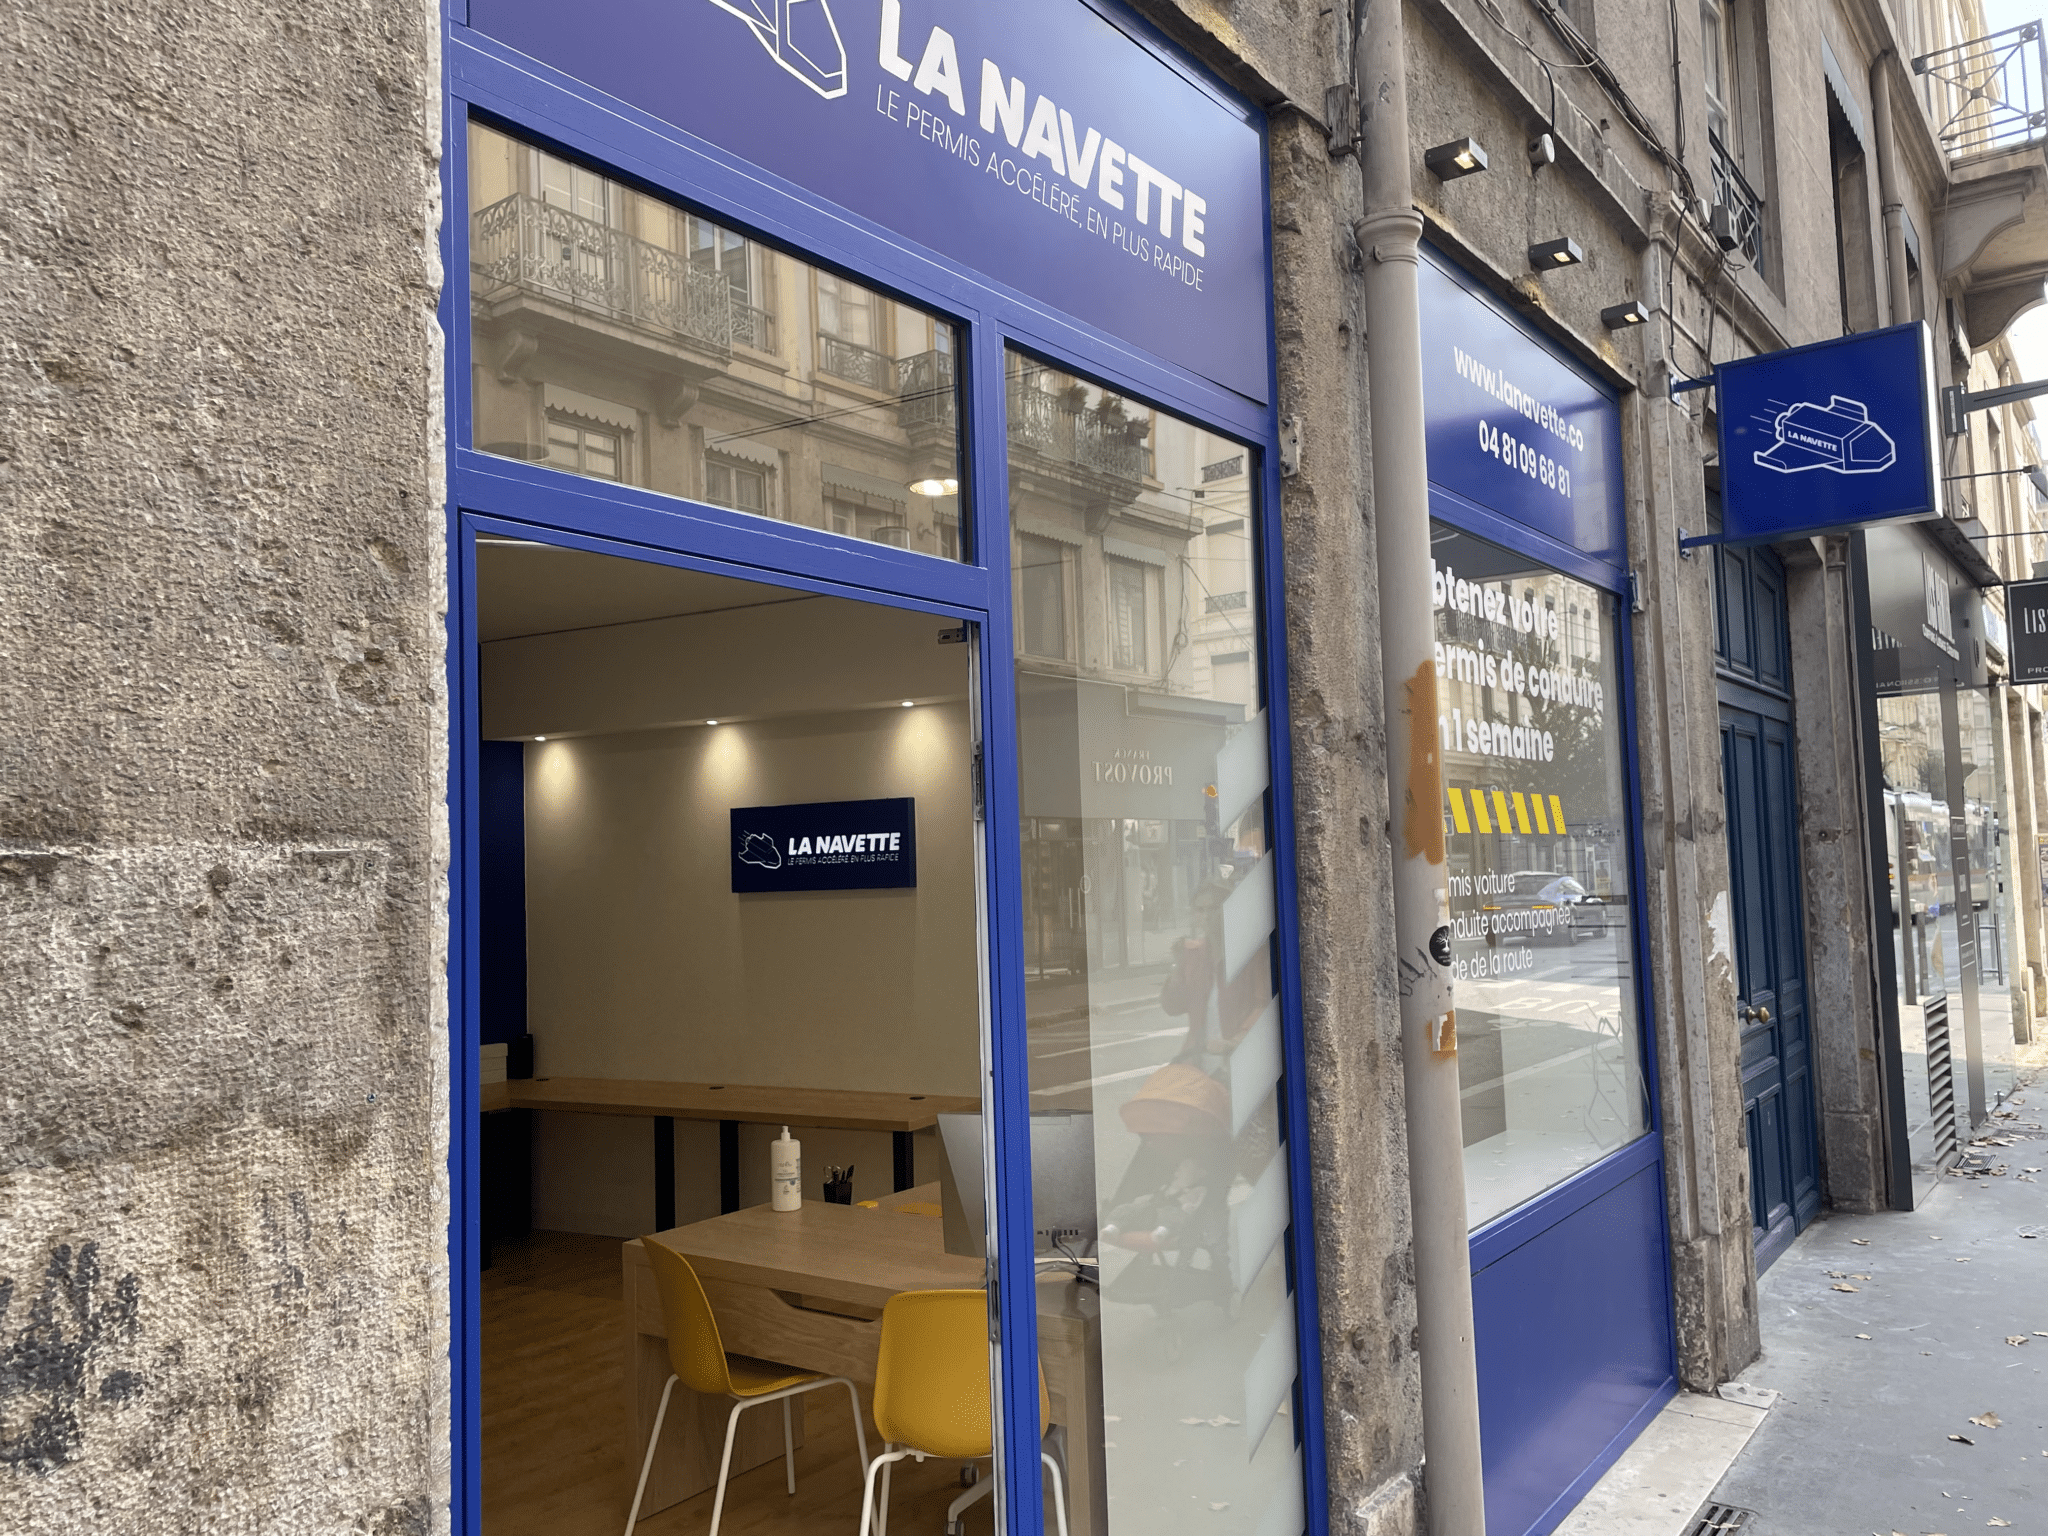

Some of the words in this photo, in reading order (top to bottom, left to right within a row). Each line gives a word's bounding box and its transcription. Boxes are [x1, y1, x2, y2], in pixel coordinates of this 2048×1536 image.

[879, 0, 966, 116] LA
[979, 58, 1208, 258] NAVETTE
[876, 83, 901, 122] LE
[906, 101, 981, 167] PERMIS
[985, 152, 1083, 229] ACCÉLÉRÉ,
[1086, 206, 1108, 240] EN
[1112, 221, 1150, 262] PLUS
[1153, 244, 1204, 292] RAPIDE
[1453, 345, 1584, 452] www.lanavette.co
[1478, 419, 1500, 459] 04
[1502, 432, 1518, 469] 81
[1519, 443, 1537, 479] 09
[1539, 453, 1556, 490] 68
[1557, 464, 1571, 499] 81
[1787, 430, 1799, 440] LA
[1799, 434, 1838, 452] NAVETTE
[1431, 558, 1507, 626] btenez
[1508, 595, 1558, 641] votre
[2023, 607, 2048, 634] LIS
[1434, 638, 1498, 689] ermis
[1500, 650, 1526, 694] de
[1528, 665, 1604, 711] conduire
[1438, 714, 1450, 751] n
[1452, 708, 1463, 752] 1
[1466, 714, 1554, 763] semaine
[788, 836, 812, 856] LA
[815, 832, 901, 854] NAVETTE
[1448, 868, 1472, 898] mis
[1473, 867, 1516, 896] voiture
[1449, 908, 1489, 940] nduite
[1451, 953, 1468, 981] de
[1470, 950, 1487, 979] de
[1488, 948, 1501, 976] la
[1503, 945, 1533, 973] route
